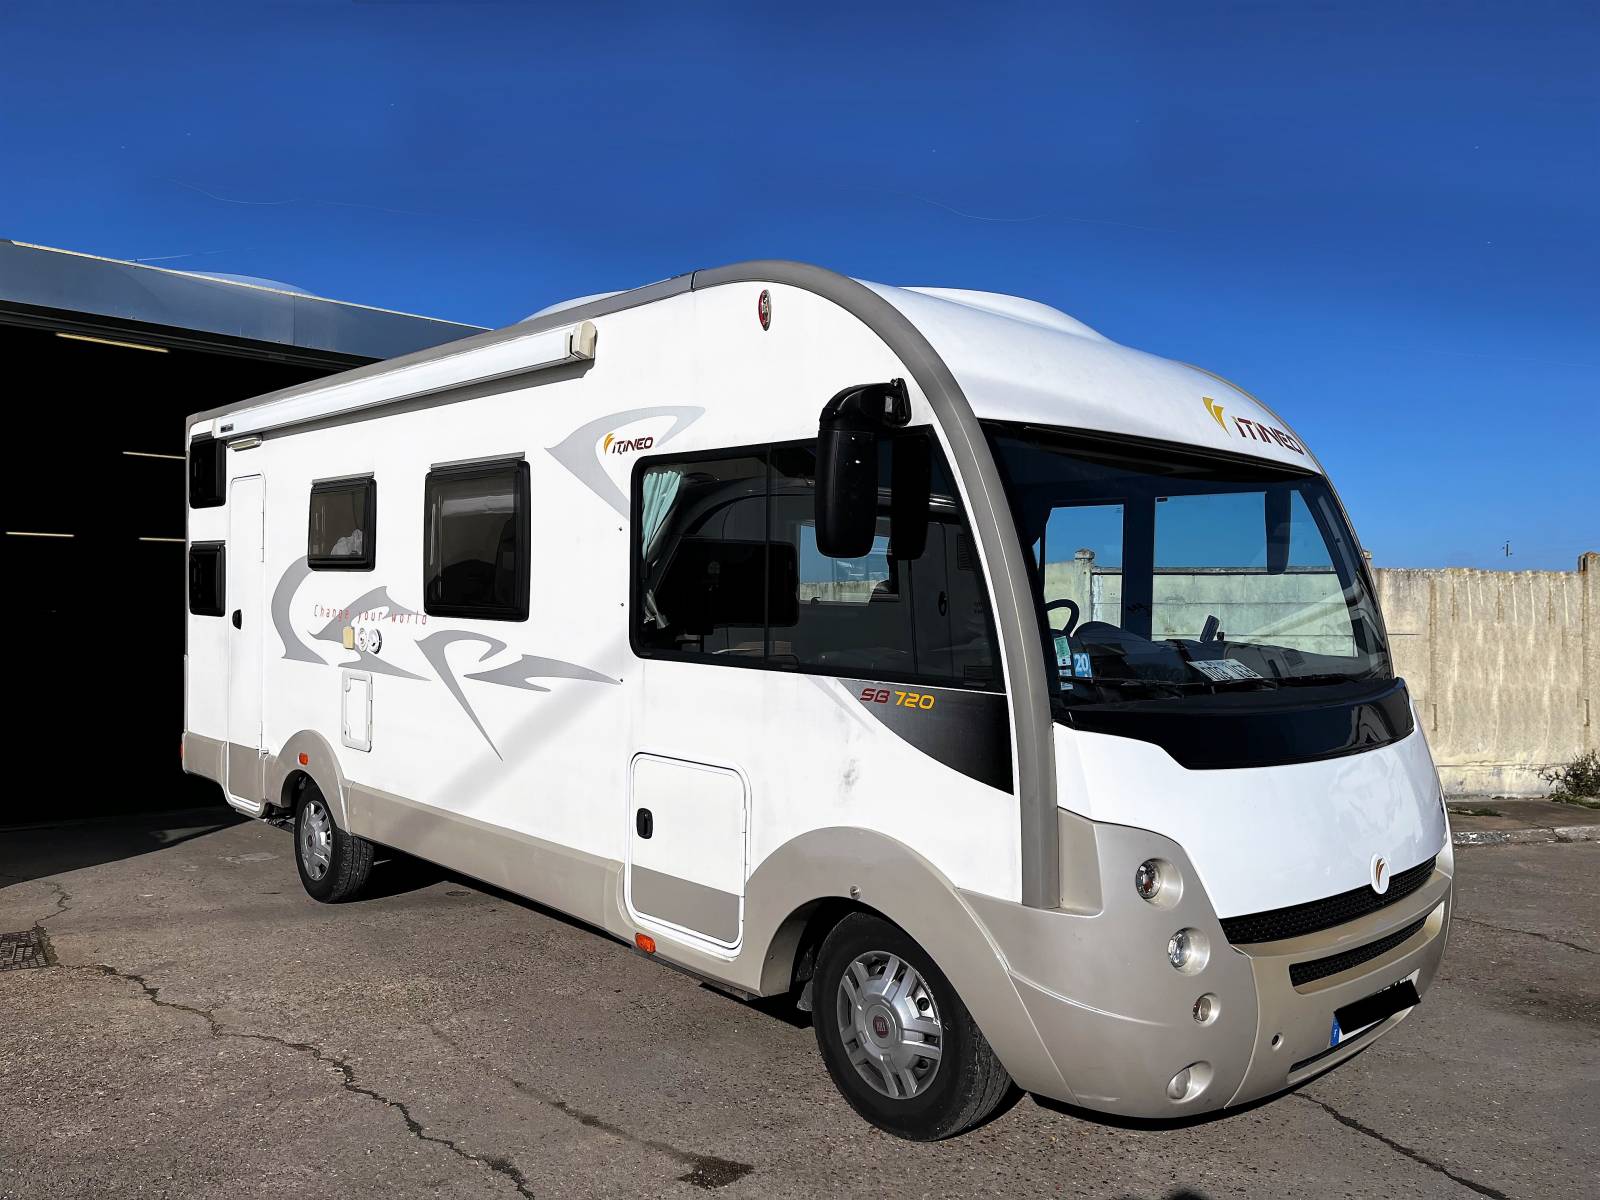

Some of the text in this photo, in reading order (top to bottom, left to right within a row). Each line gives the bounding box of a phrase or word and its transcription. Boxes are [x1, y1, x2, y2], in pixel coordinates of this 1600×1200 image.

[313, 604, 428, 625] Change your world
[860, 688, 936, 710] SB 720
